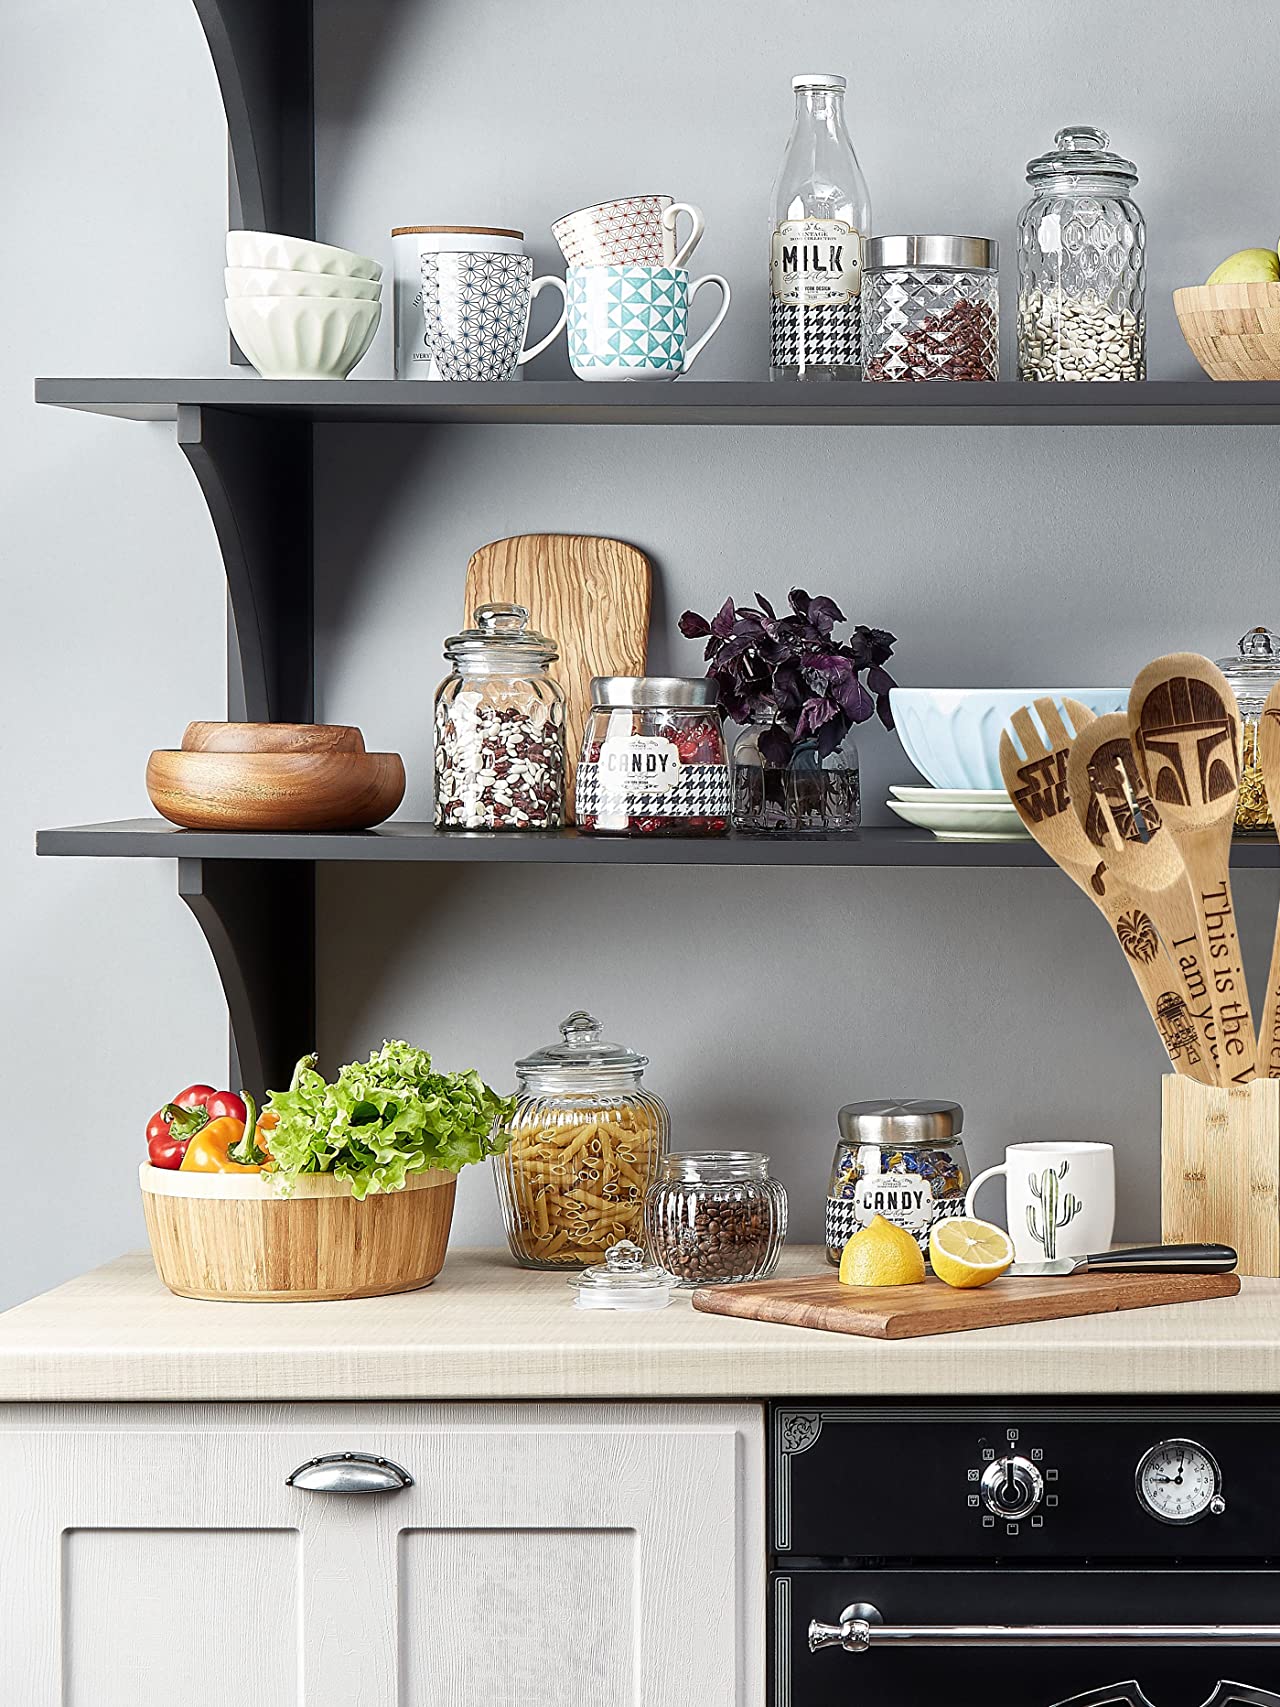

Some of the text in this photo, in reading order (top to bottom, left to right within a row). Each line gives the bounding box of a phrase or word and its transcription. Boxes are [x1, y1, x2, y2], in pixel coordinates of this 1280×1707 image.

[782, 245, 843, 272] MILK
[608, 753, 669, 773] CANDY
[1201, 881, 1234, 958] This
[1172, 933, 1197, 949] I
[1179, 954, 1207, 1000] am
[1213, 967, 1241, 993] is
[1219, 1001, 1249, 1056] the
[863, 1191, 923, 1209] CANDY
